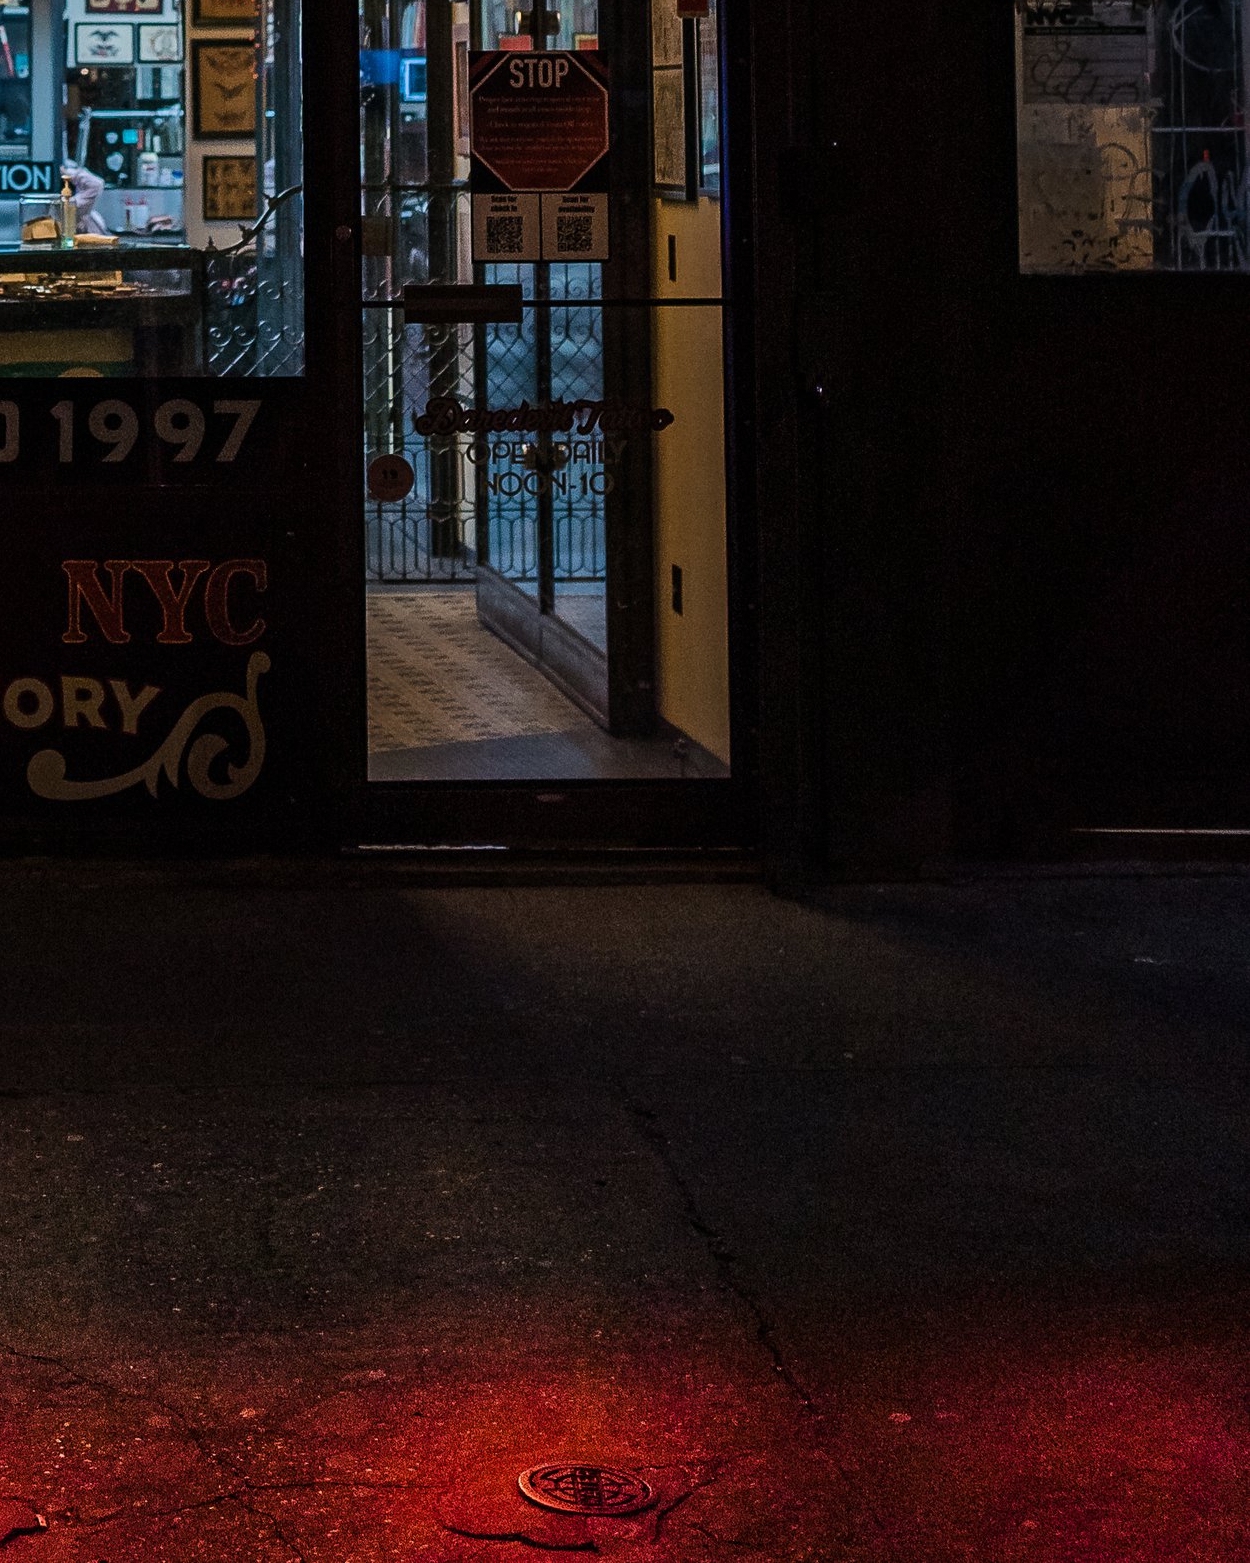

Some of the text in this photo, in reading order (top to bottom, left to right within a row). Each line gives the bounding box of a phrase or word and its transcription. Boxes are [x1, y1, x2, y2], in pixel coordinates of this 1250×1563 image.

[509, 58, 569, 89] STOP
[50, 398, 264, 463] 1997
[60, 558, 268, 646] NYC
